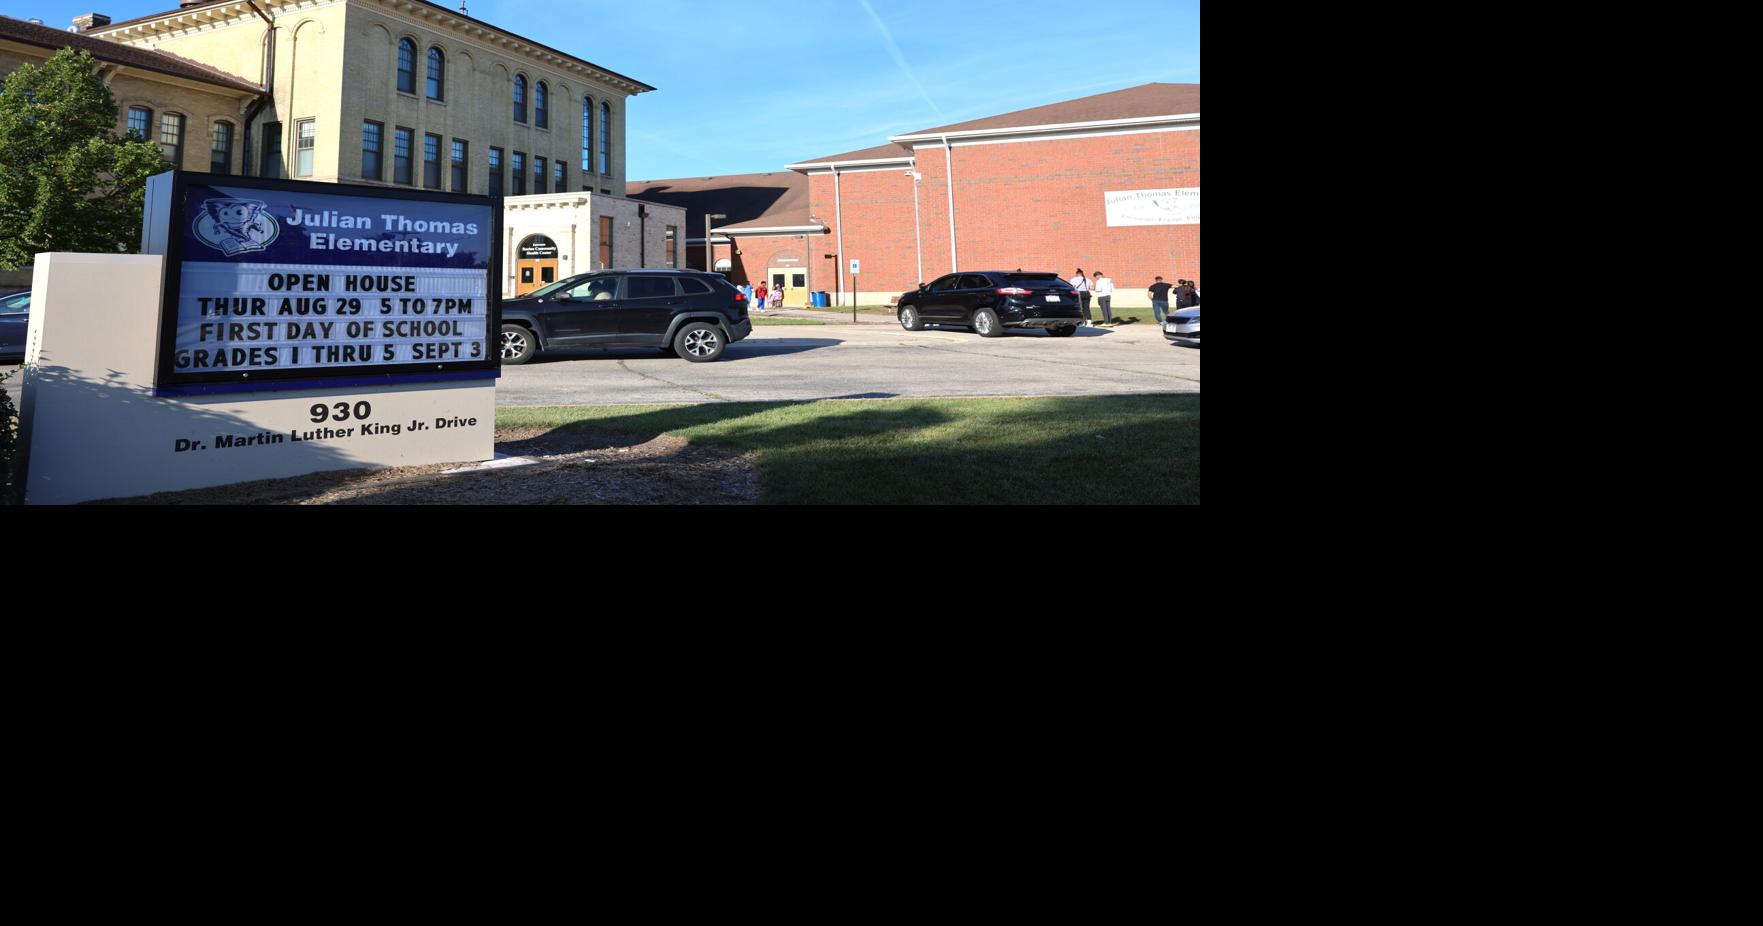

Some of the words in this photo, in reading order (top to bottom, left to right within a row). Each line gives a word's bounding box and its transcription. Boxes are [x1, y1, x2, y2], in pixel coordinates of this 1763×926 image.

[1136, 190, 1171, 199] Thomas
[286, 208, 371, 229] Julian
[381, 214, 478, 235] Thomas
[309, 232, 458, 258] Elementary
[268, 273, 330, 292] OPEN
[345, 275, 416, 292] HOUSE
[198, 297, 266, 316] THUR
[278, 297, 327, 315] AUG
[336, 298, 361, 315] 29
[380, 298, 392, 314] 5
[399, 298, 426, 315] TO
[432, 298, 472, 314] 7PM
[199, 322, 278, 342] FIRST
[287, 321, 334, 340] DAY
[346, 320, 374, 338] OF
[382, 320, 462, 338] SCHOOL
[174, 347, 278, 368] GRADES
[312, 344, 372, 363] THRU
[383, 343, 395, 361] 5
[412, 342, 462, 360] SEPT
[470, 341, 481, 358] 3
[310, 400, 372, 423] 930
[175, 438, 206, 452] Dr.
[215, 431, 283, 449] Martin
[291, 426, 354, 442] Luther
[361, 422, 401, 436] King
[407, 419, 429, 432] Jr.
[435, 416, 477, 429] Drive
